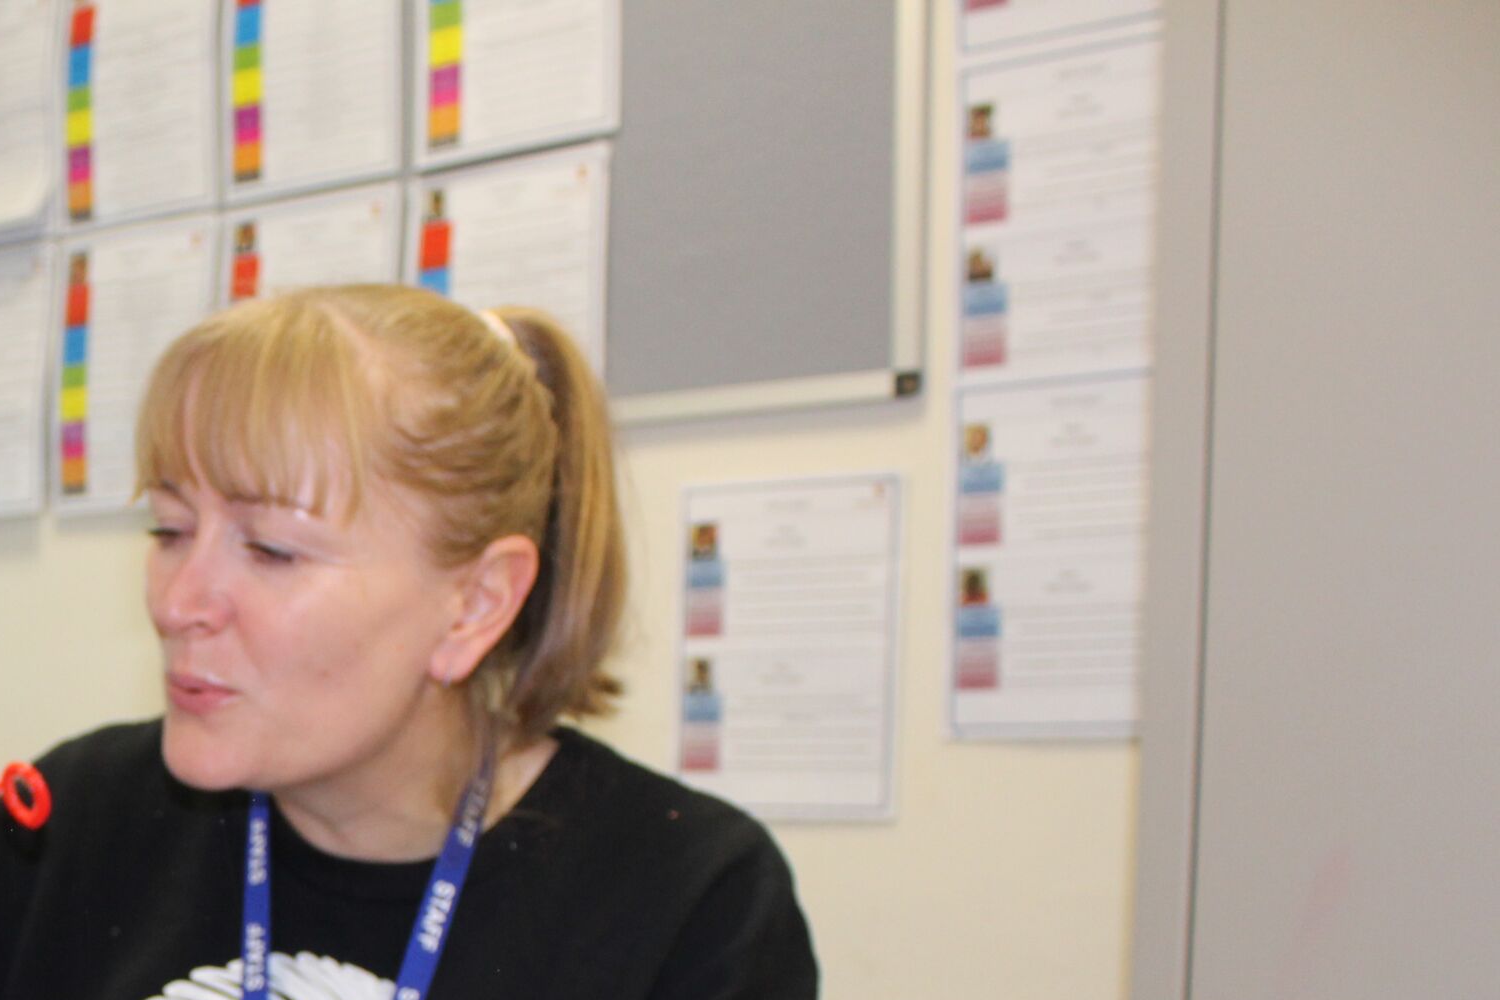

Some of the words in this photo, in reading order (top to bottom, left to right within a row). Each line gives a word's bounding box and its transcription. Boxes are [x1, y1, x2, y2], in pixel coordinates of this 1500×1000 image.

[248, 818, 268, 886] STAFF
[418, 879, 456, 954] STAFF
[244, 922, 266, 992] STAFF
